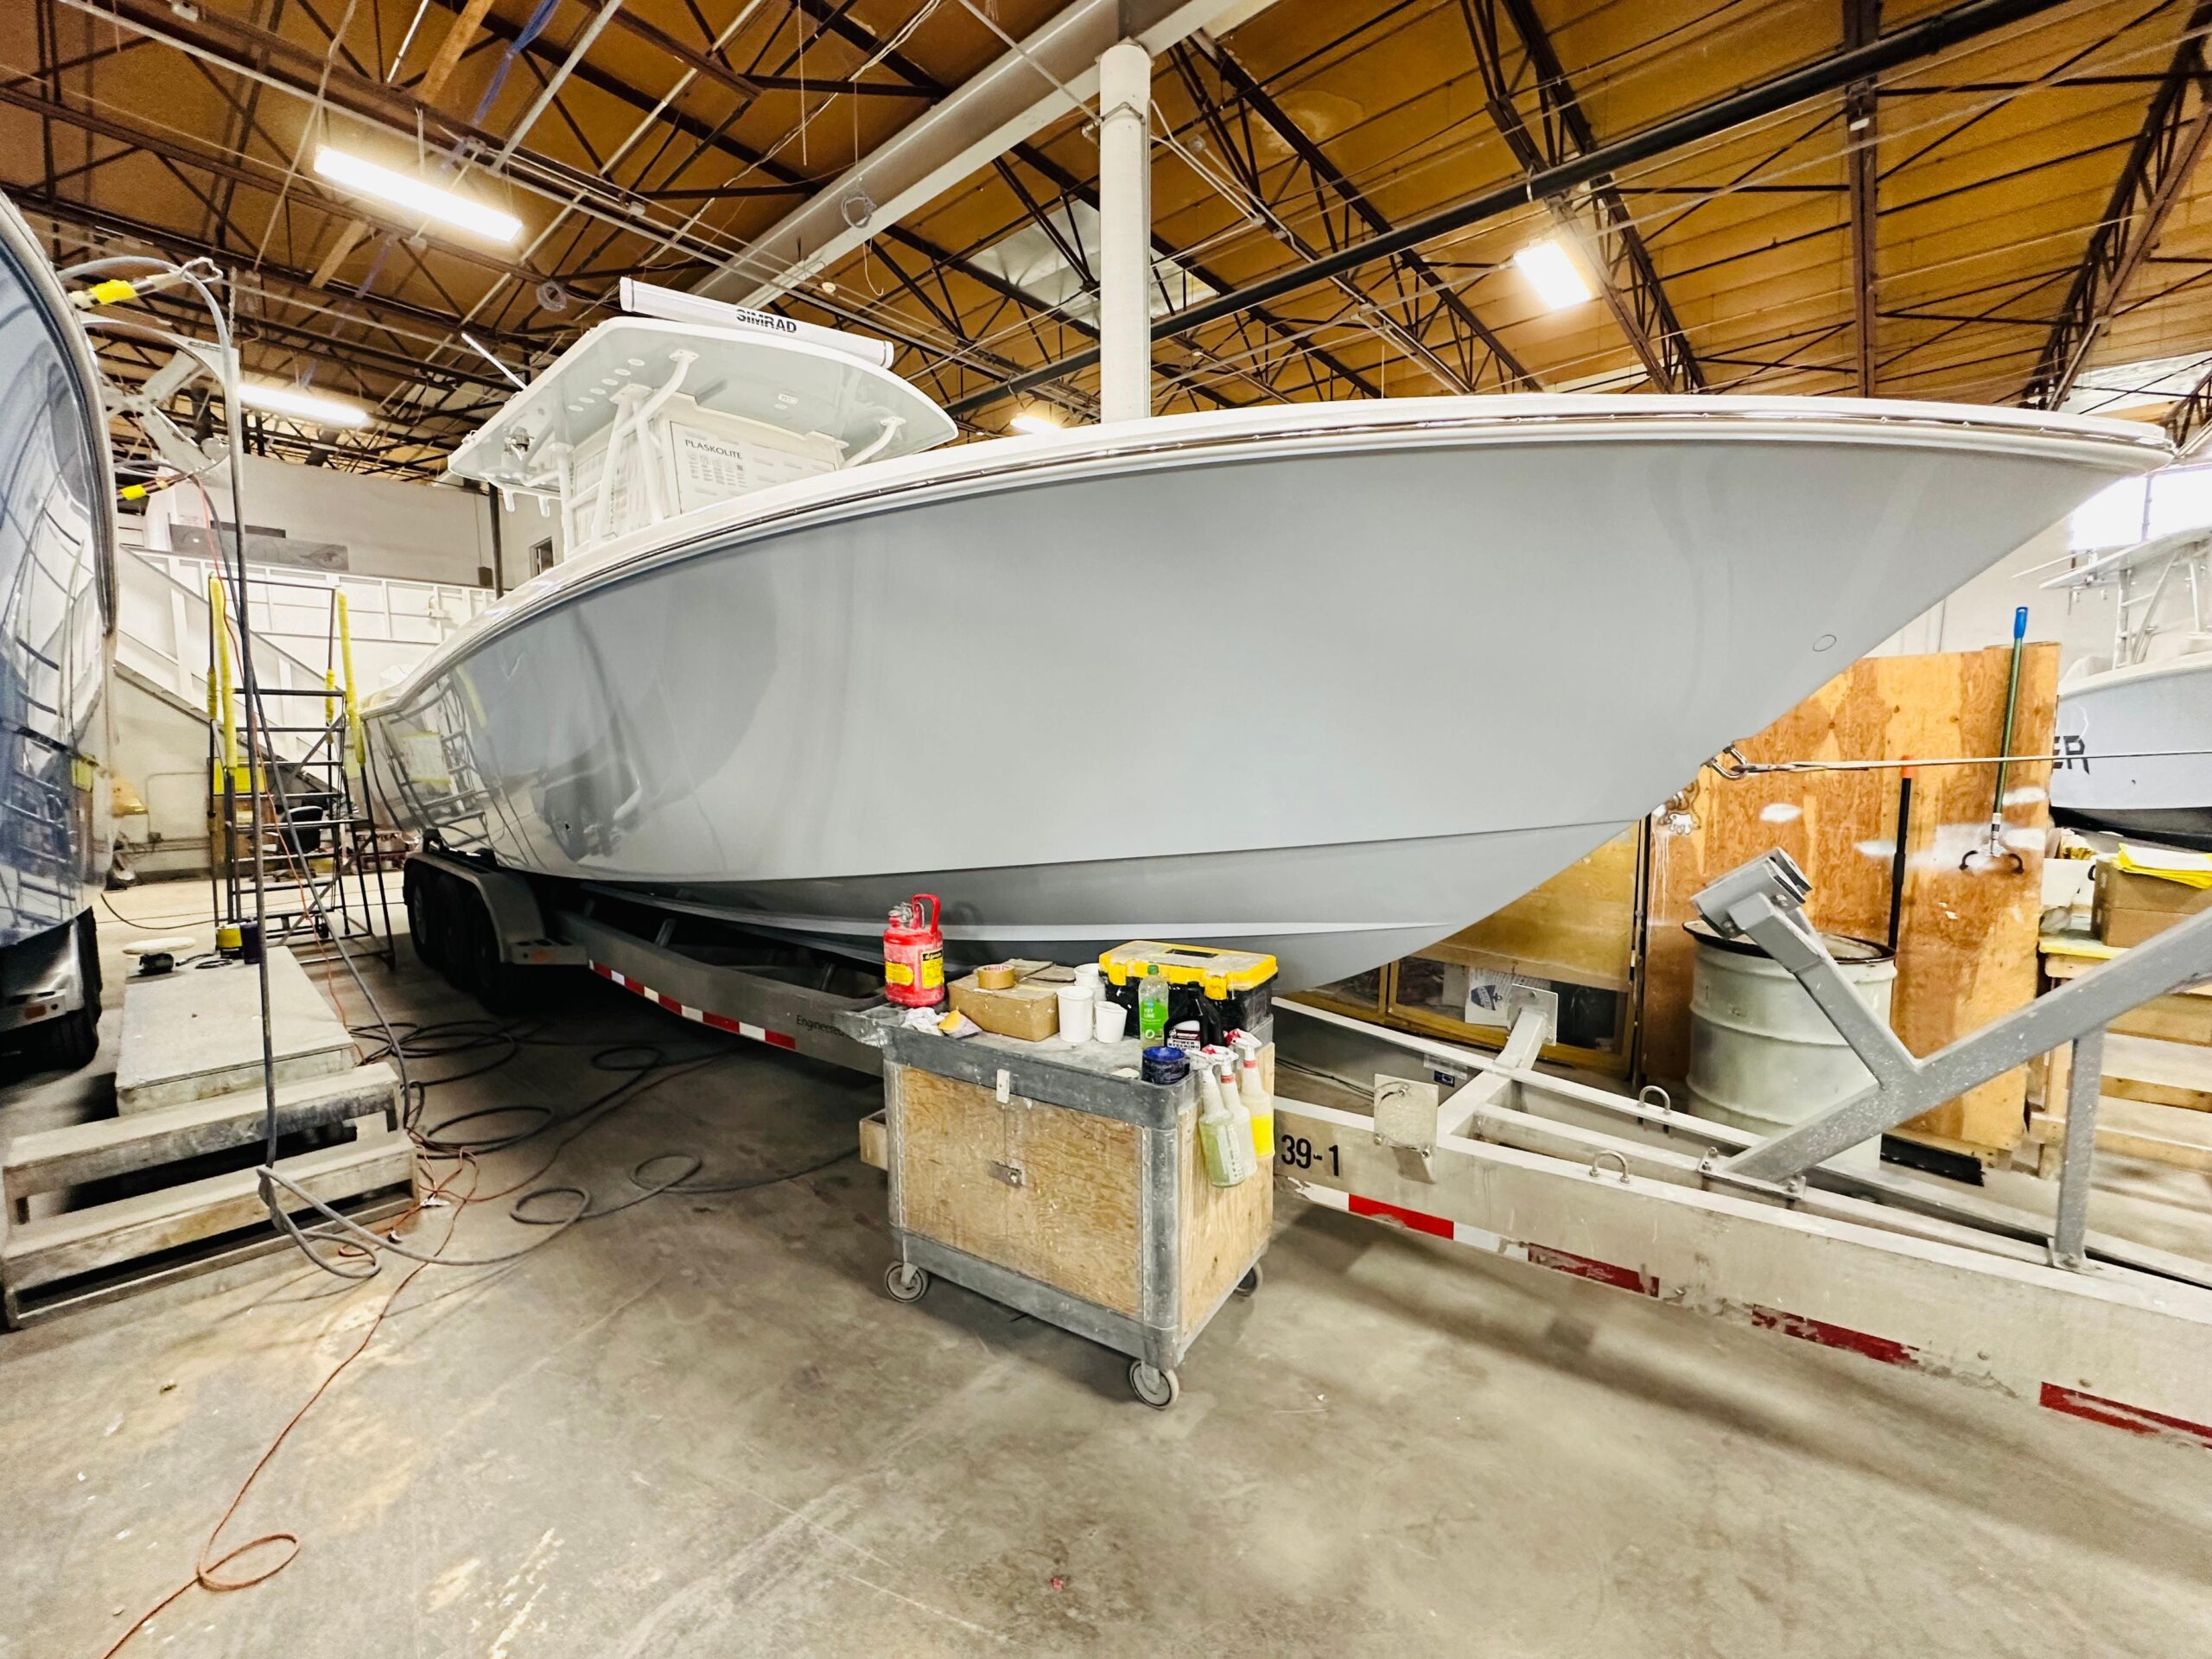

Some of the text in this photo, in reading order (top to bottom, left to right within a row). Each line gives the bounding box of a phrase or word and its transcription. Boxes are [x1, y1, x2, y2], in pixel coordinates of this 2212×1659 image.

[736, 308, 797, 334] SIMRAD
[684, 438, 743, 460] PLASKOLITE
[1281, 1134, 1339, 1177] 39-1
